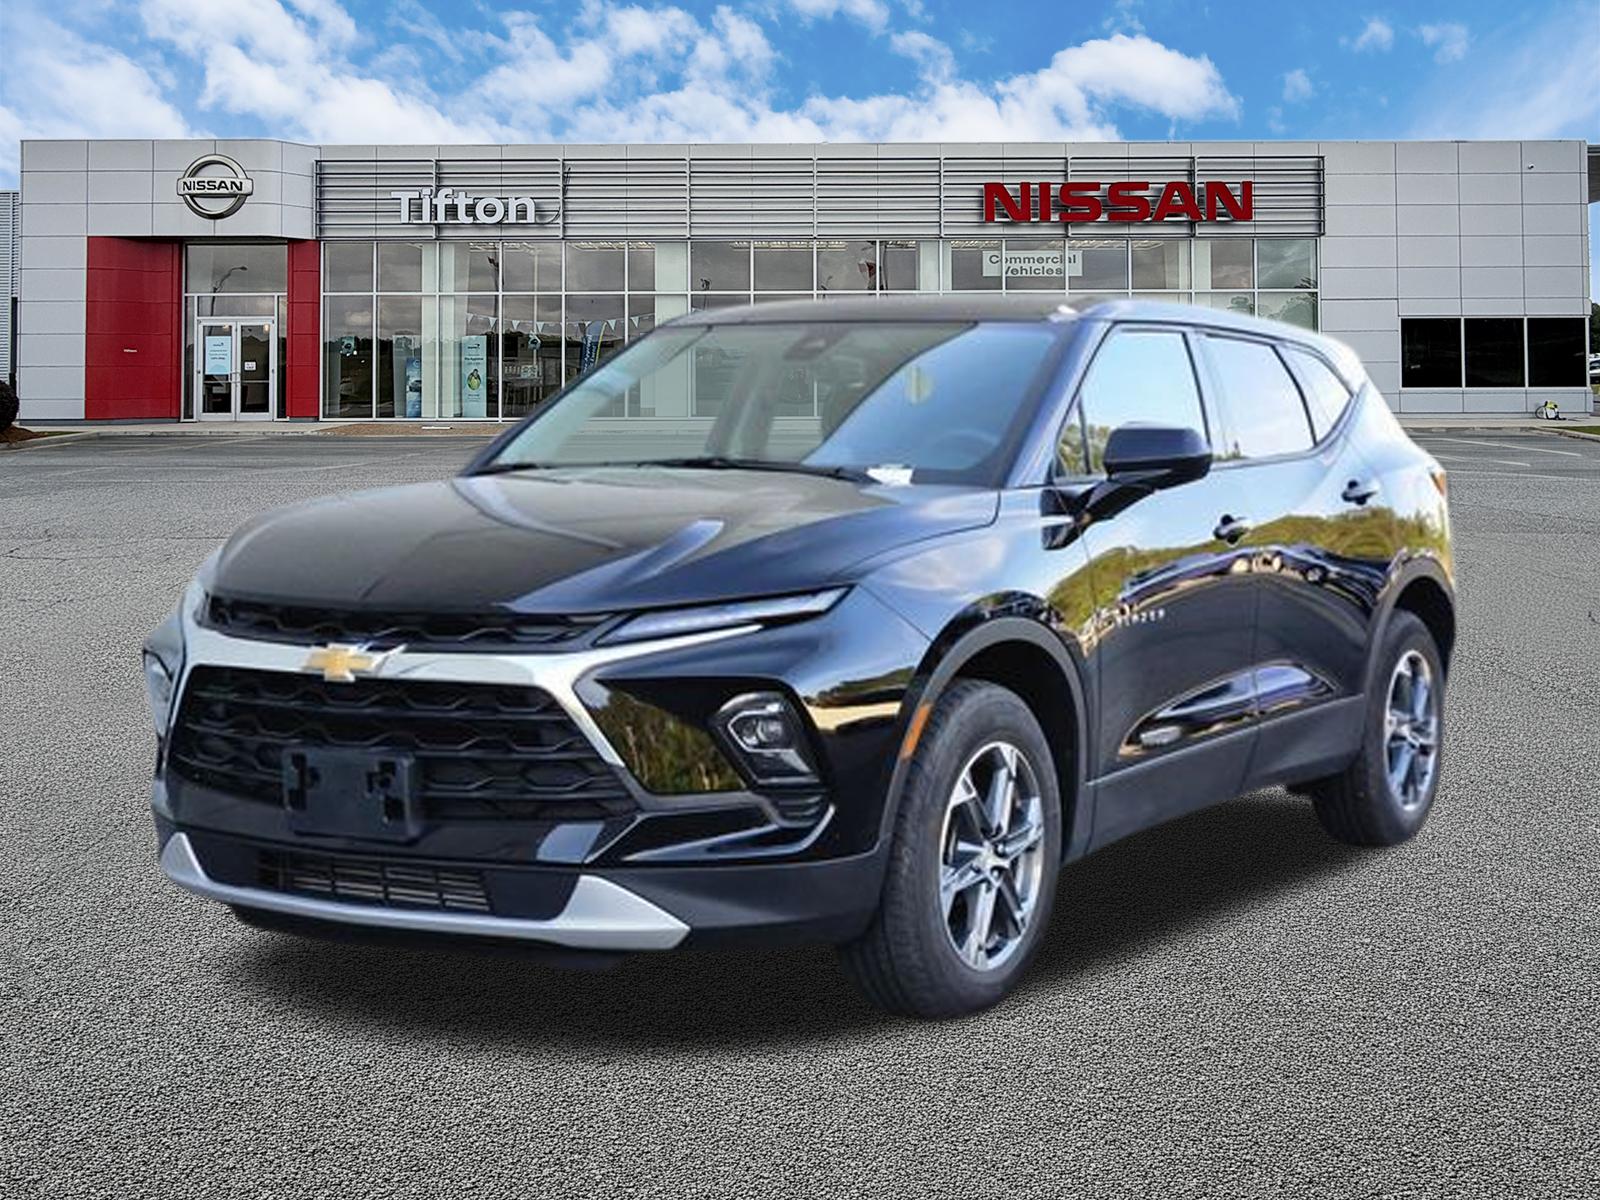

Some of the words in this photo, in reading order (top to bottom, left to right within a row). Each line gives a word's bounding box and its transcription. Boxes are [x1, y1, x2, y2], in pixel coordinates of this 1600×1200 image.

[182, 180, 243, 192] NISSAN
[983, 181, 1253, 223] NISSAN
[391, 187, 536, 224] Tifton
